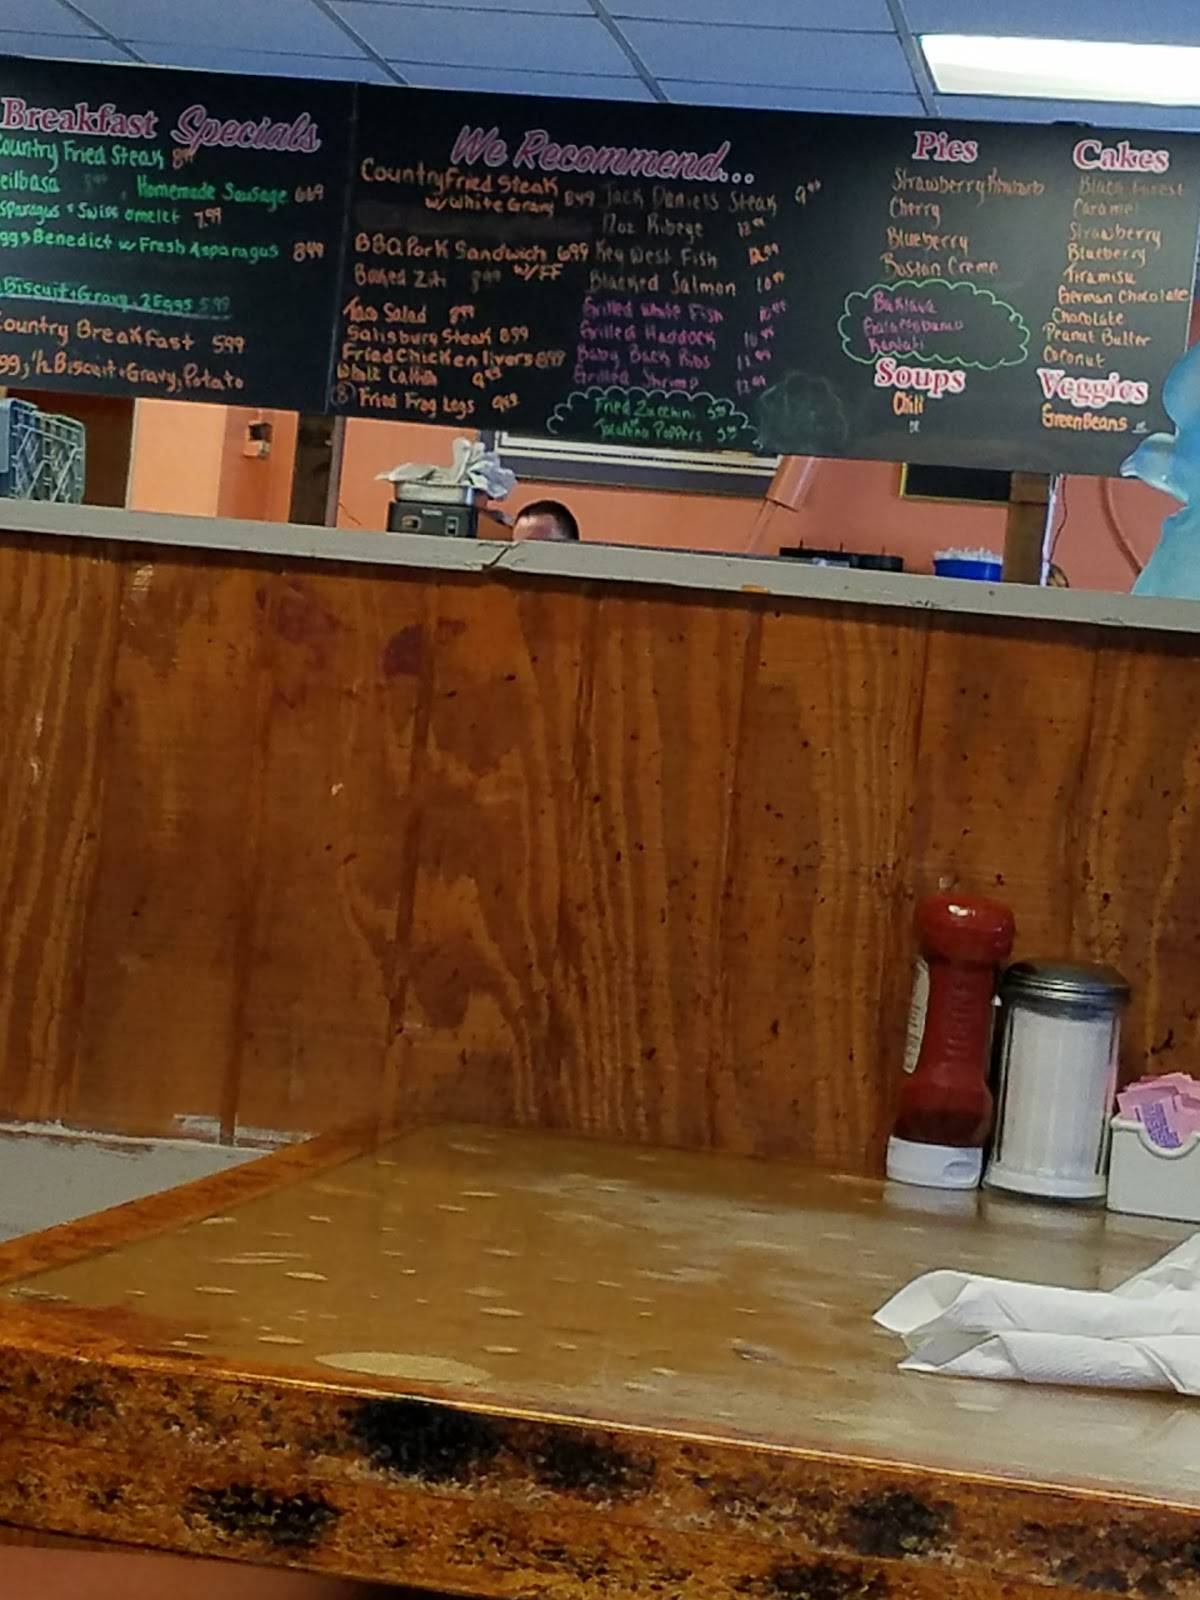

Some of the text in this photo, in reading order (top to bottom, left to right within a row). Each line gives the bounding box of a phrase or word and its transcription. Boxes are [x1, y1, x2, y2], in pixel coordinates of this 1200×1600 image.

[0, 97, 322, 153] Breakfast Specials
[63, 140, 106, 165] Fried
[111, 144, 164, 170] Steak
[450, 124, 508, 167] We
[912, 130, 979, 162] Pies
[1073, 139, 1170, 173] Cakes
[0, 169, 60, 192] eilbasa
[137, 174, 216, 200] Homemade
[361, 157, 448, 194] Country
[497, 175, 559, 195] Steak
[0, 200, 60, 226] sparagus
[79, 201, 118, 219] Swiss
[889, 196, 941, 229] Cherry
[0, 231, 31, 247] ggs
[33, 228, 113, 250] Benedict
[139, 236, 186, 254] Fresh
[355, 232, 402, 256] BBQ
[455, 239, 548, 262] Sandwich
[887, 226, 970, 256] Blueberry
[1069, 221, 1161, 249] Strawberry
[1066, 243, 1146, 268] Blueberry
[672, 269, 737, 297] Salmon
[383, 302, 428, 324] Salad
[77, 319, 194, 351] Breakfast
[441, 328, 492, 346] Steak
[874, 357, 966, 398] Soups
[1036, 368, 1149, 409] Veggies
[404, 391, 438, 418] Frog
[442, 396, 477, 420] Legs
